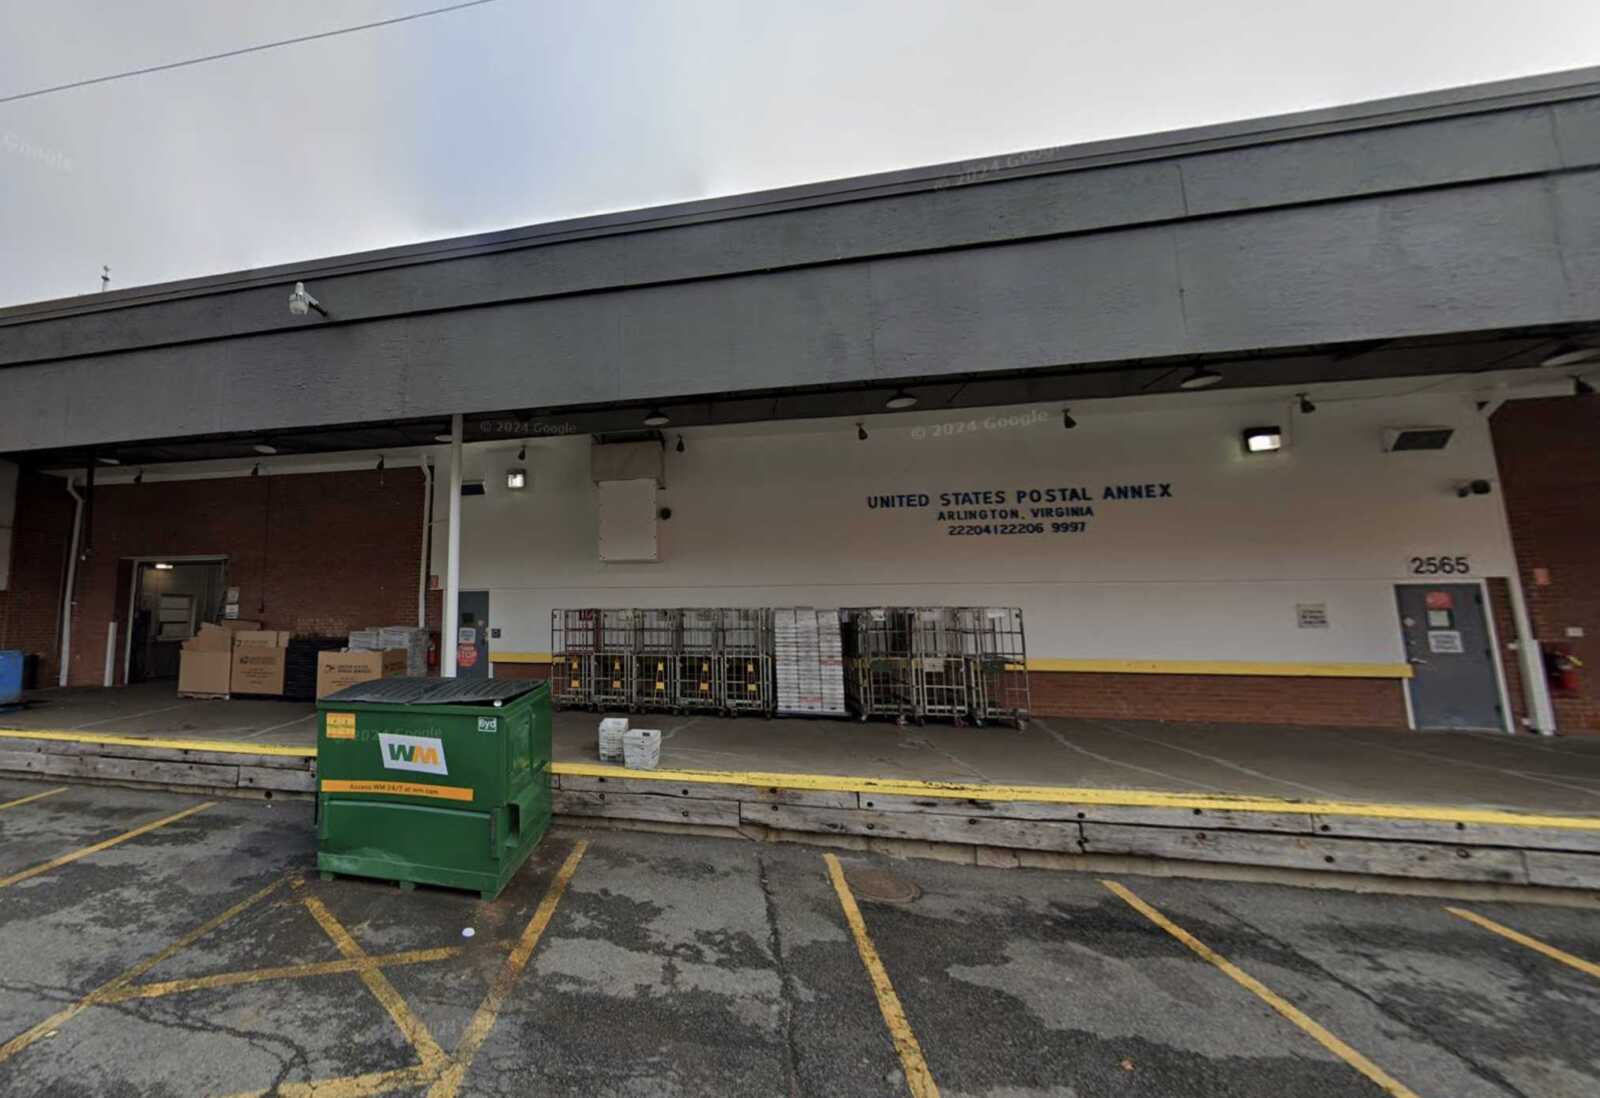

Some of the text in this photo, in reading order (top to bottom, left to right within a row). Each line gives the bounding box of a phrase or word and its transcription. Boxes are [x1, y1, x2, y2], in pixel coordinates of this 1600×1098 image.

[868, 483, 1172, 509] UNITED STATES POSTAL ANNEX
[1030, 506, 1094, 518] VIRGINIA
[1051, 521, 1086, 533] 9997
[1411, 556, 1470, 575] 2565
[388, 743, 441, 765] WM
